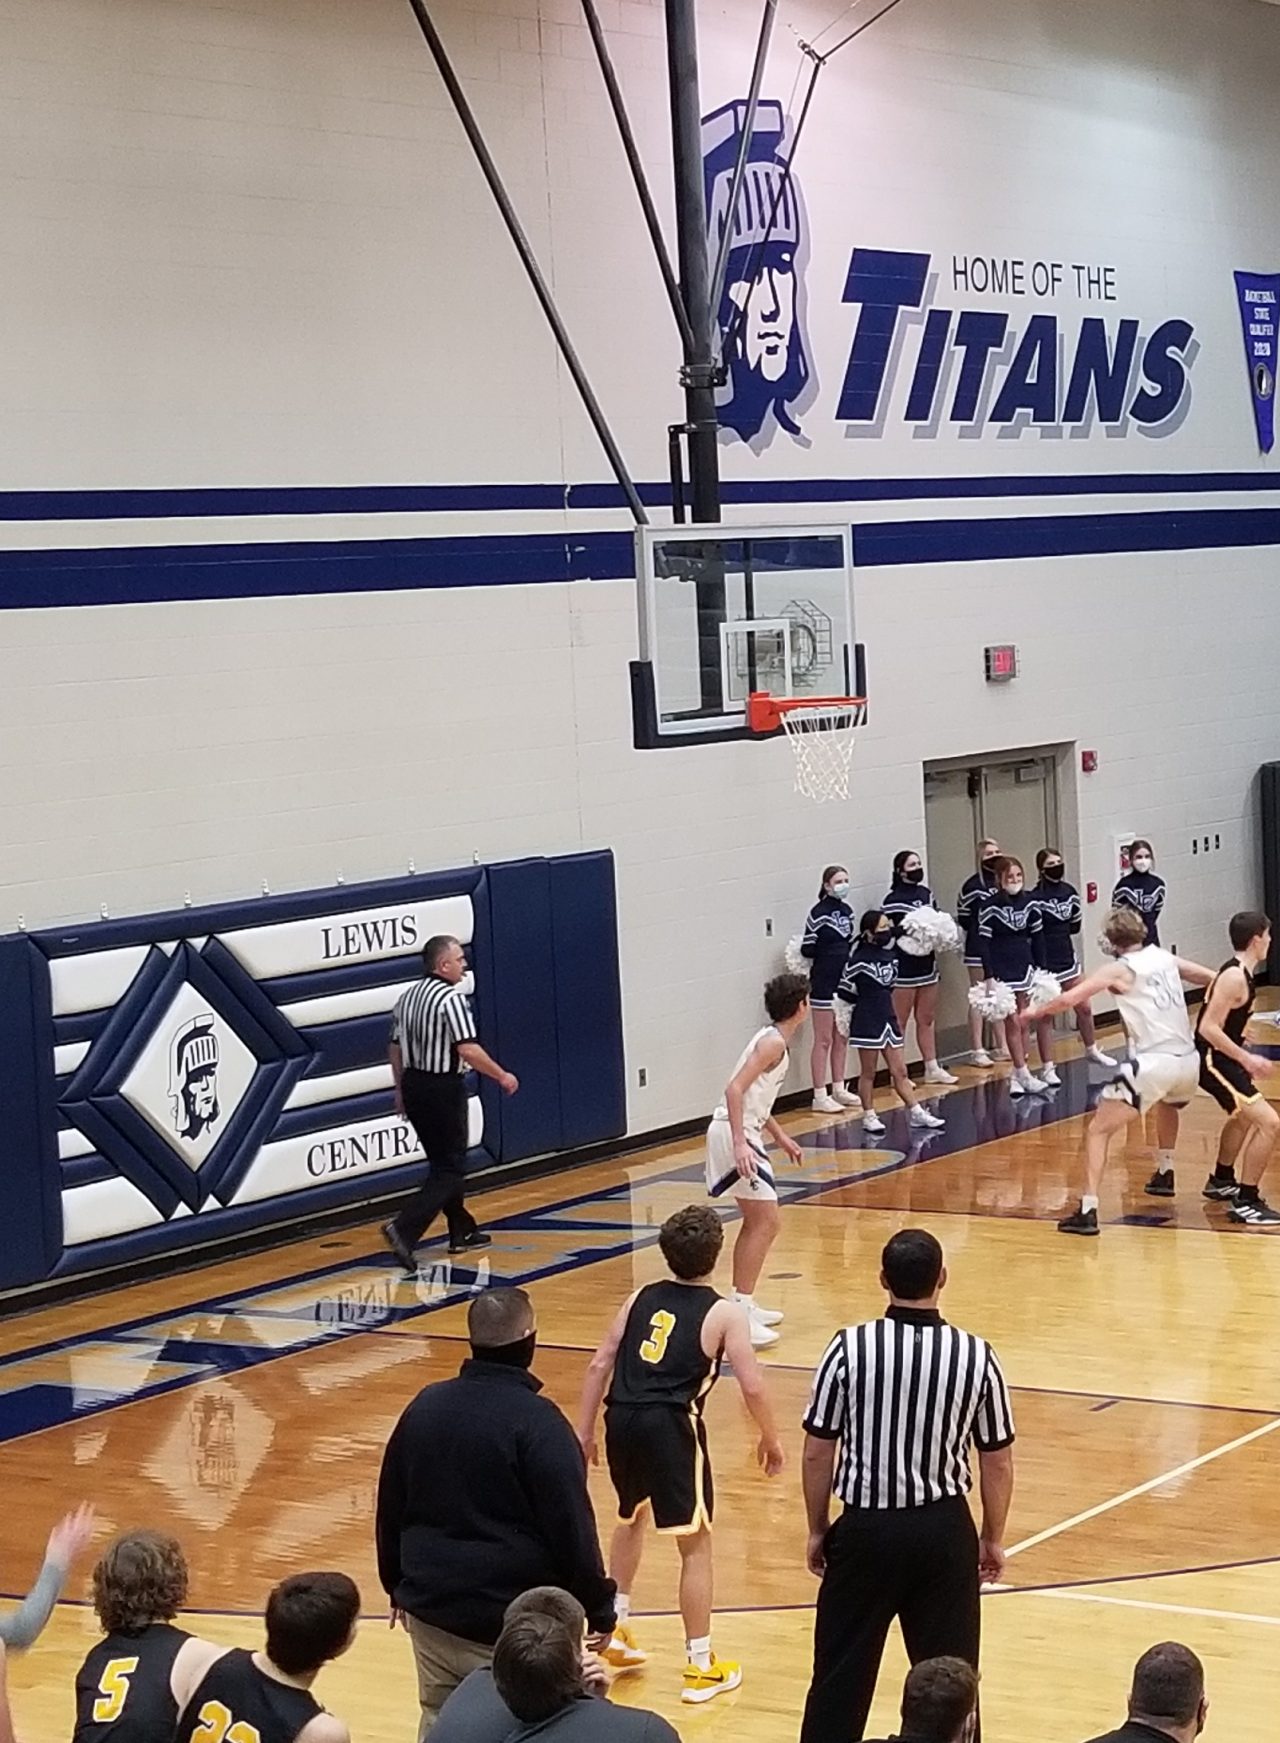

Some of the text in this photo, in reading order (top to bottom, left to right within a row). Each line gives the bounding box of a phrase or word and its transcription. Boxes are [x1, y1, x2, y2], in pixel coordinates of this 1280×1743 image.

[952, 255, 1117, 301] HOME OF THE
[835, 247, 1197, 431] TITANS
[320, 914, 418, 960] LEWIS
[306, 1124, 424, 1178] CENTR
[639, 1309, 676, 1364] 3
[92, 1656, 140, 1723] 5
